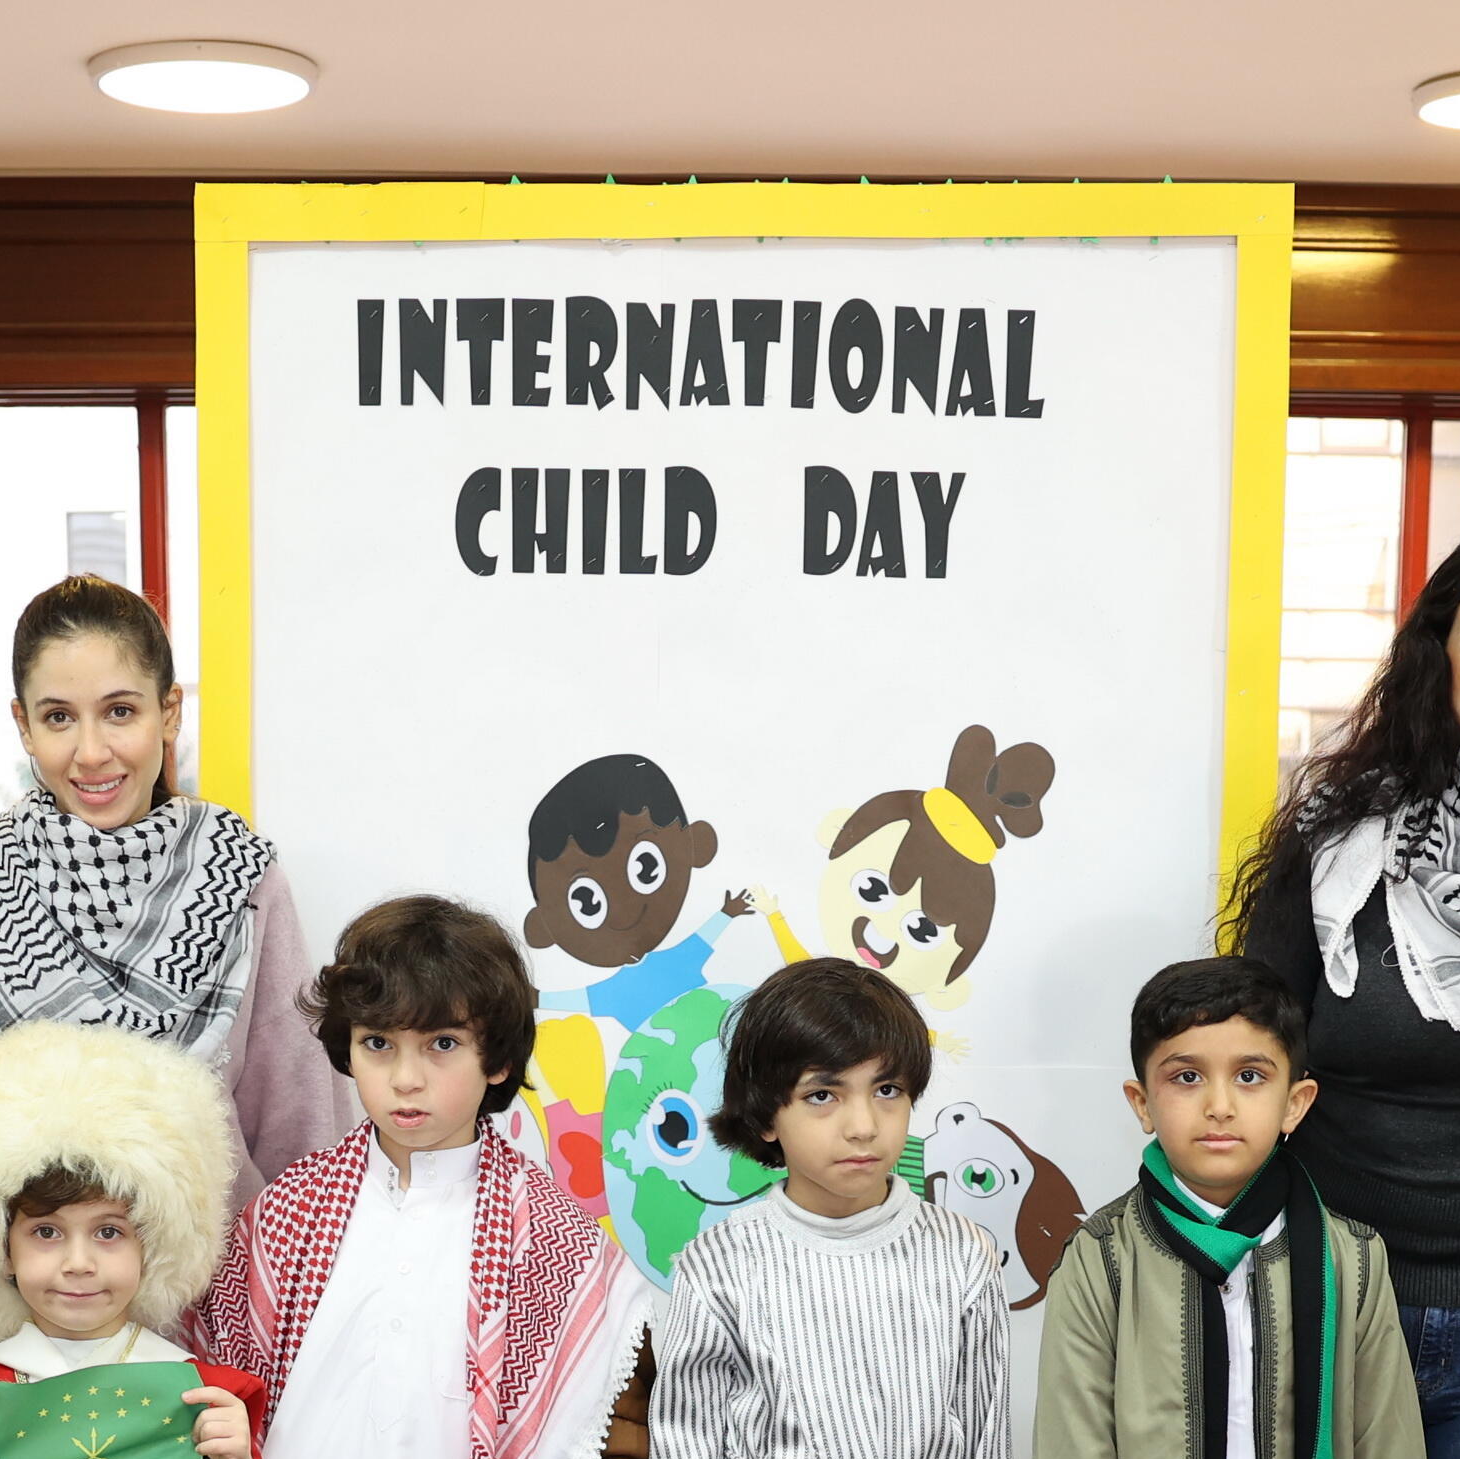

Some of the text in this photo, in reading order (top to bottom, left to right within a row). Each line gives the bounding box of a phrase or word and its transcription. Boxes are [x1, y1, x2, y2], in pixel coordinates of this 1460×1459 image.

[356, 295, 1045, 419] INTERNATIONAL
[454, 465, 966, 579] CHILD DAY
